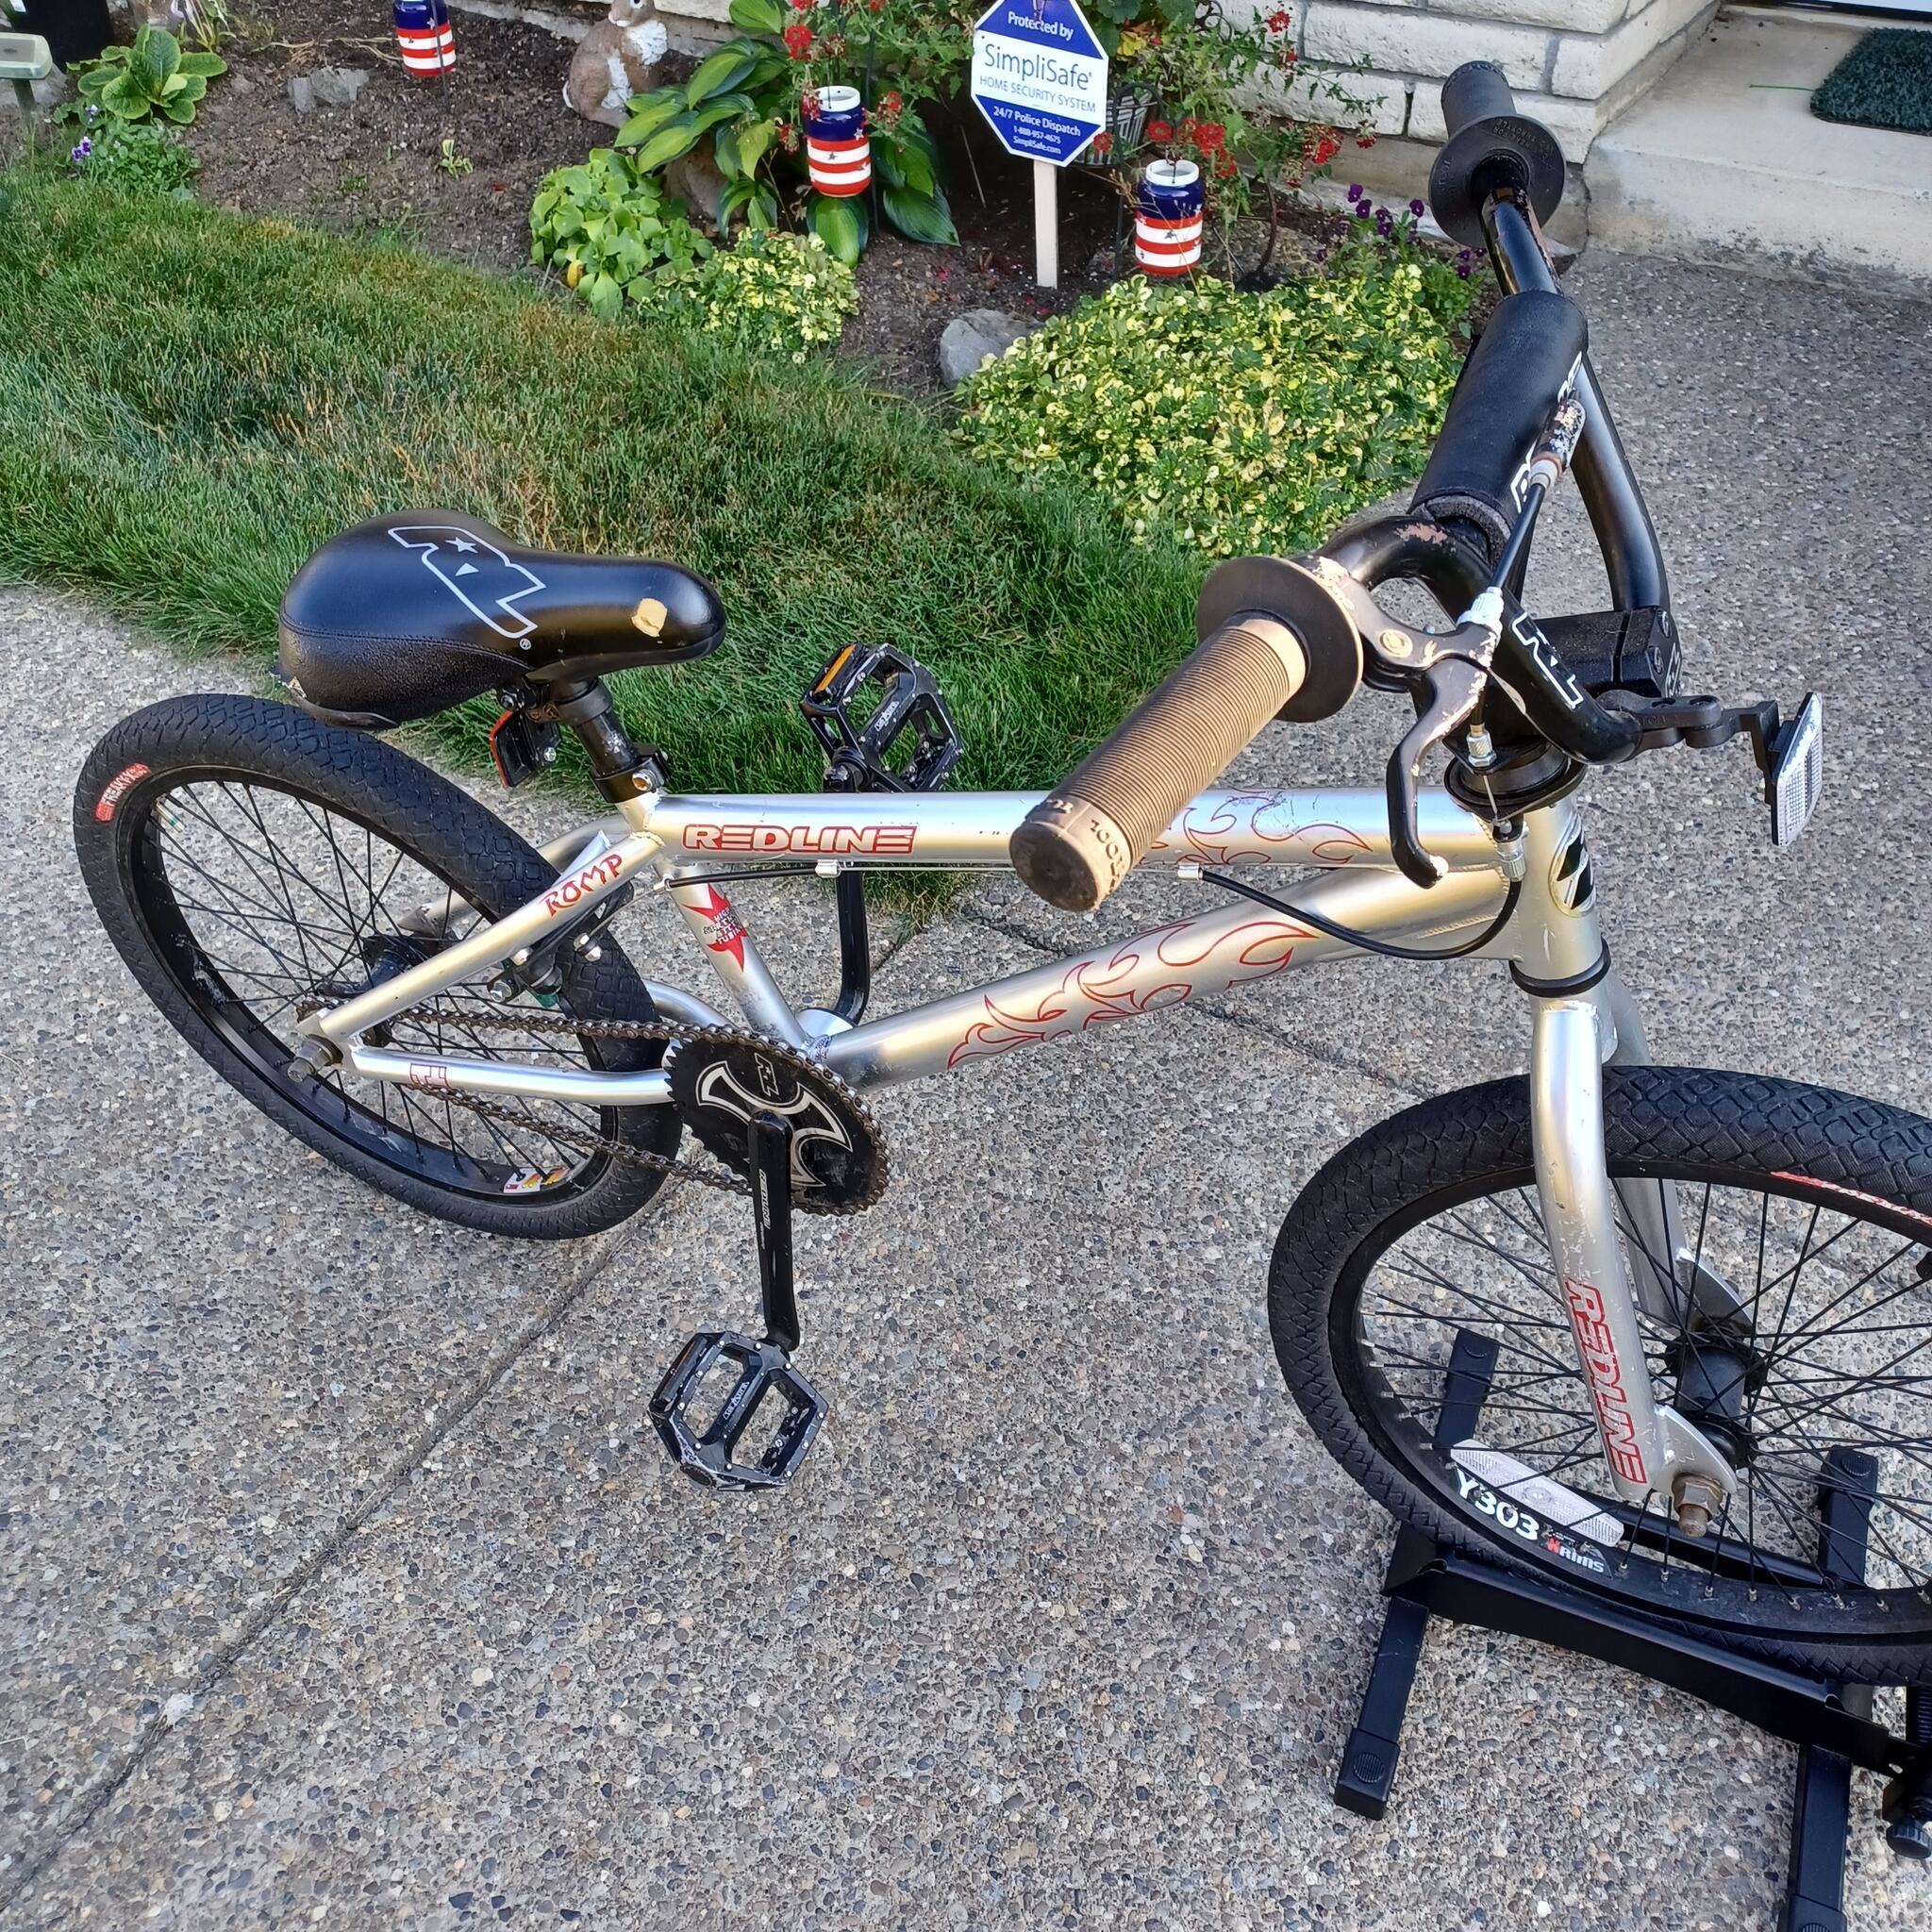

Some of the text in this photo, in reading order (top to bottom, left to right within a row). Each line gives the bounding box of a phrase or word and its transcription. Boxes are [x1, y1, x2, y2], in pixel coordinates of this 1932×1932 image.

[1008, 11, 1074, 41] Protected by
[985, 43, 1091, 91] SimpliSafe
[980, 75, 1096, 114] HOME SECURITY SYSTEM
[993, 106, 1081, 137] 24/7 Police Dispatch
[683, 824, 918, 855] REDLINE
[539, 853, 624, 917] ROMP
[1565, 1277, 1647, 1484] REDLINE
[1455, 1467, 1541, 1541] Y303
